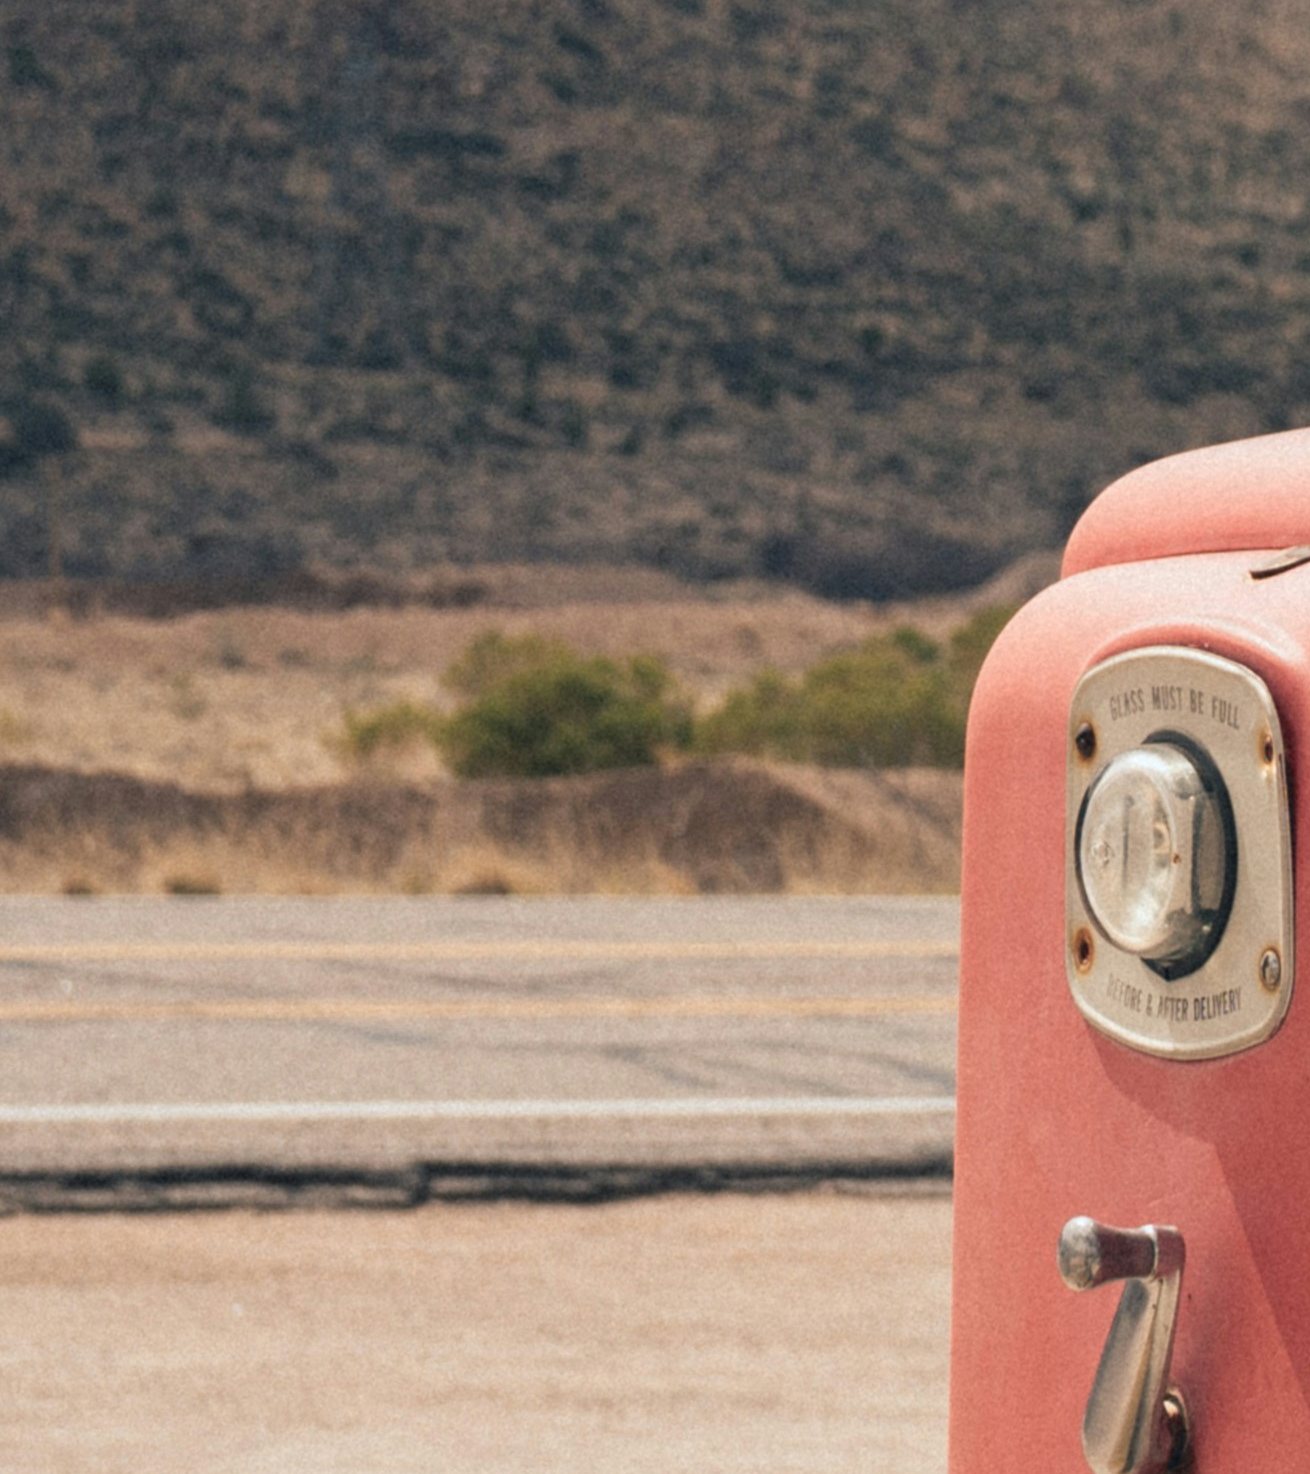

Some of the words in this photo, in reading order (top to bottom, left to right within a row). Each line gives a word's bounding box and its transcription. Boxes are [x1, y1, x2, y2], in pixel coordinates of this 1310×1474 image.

[1109, 688, 1145, 721] GLASS
[1151, 685, 1183, 712] MUST
[1189, 689, 1204, 715] BE
[1211, 695, 1240, 730] FULL
[1106, 973, 1143, 1013] BEFORE
[1145, 993, 1153, 1017] &
[1157, 995, 1189, 1022] AFTER
[1193, 986, 1242, 1022] DELIVERY
